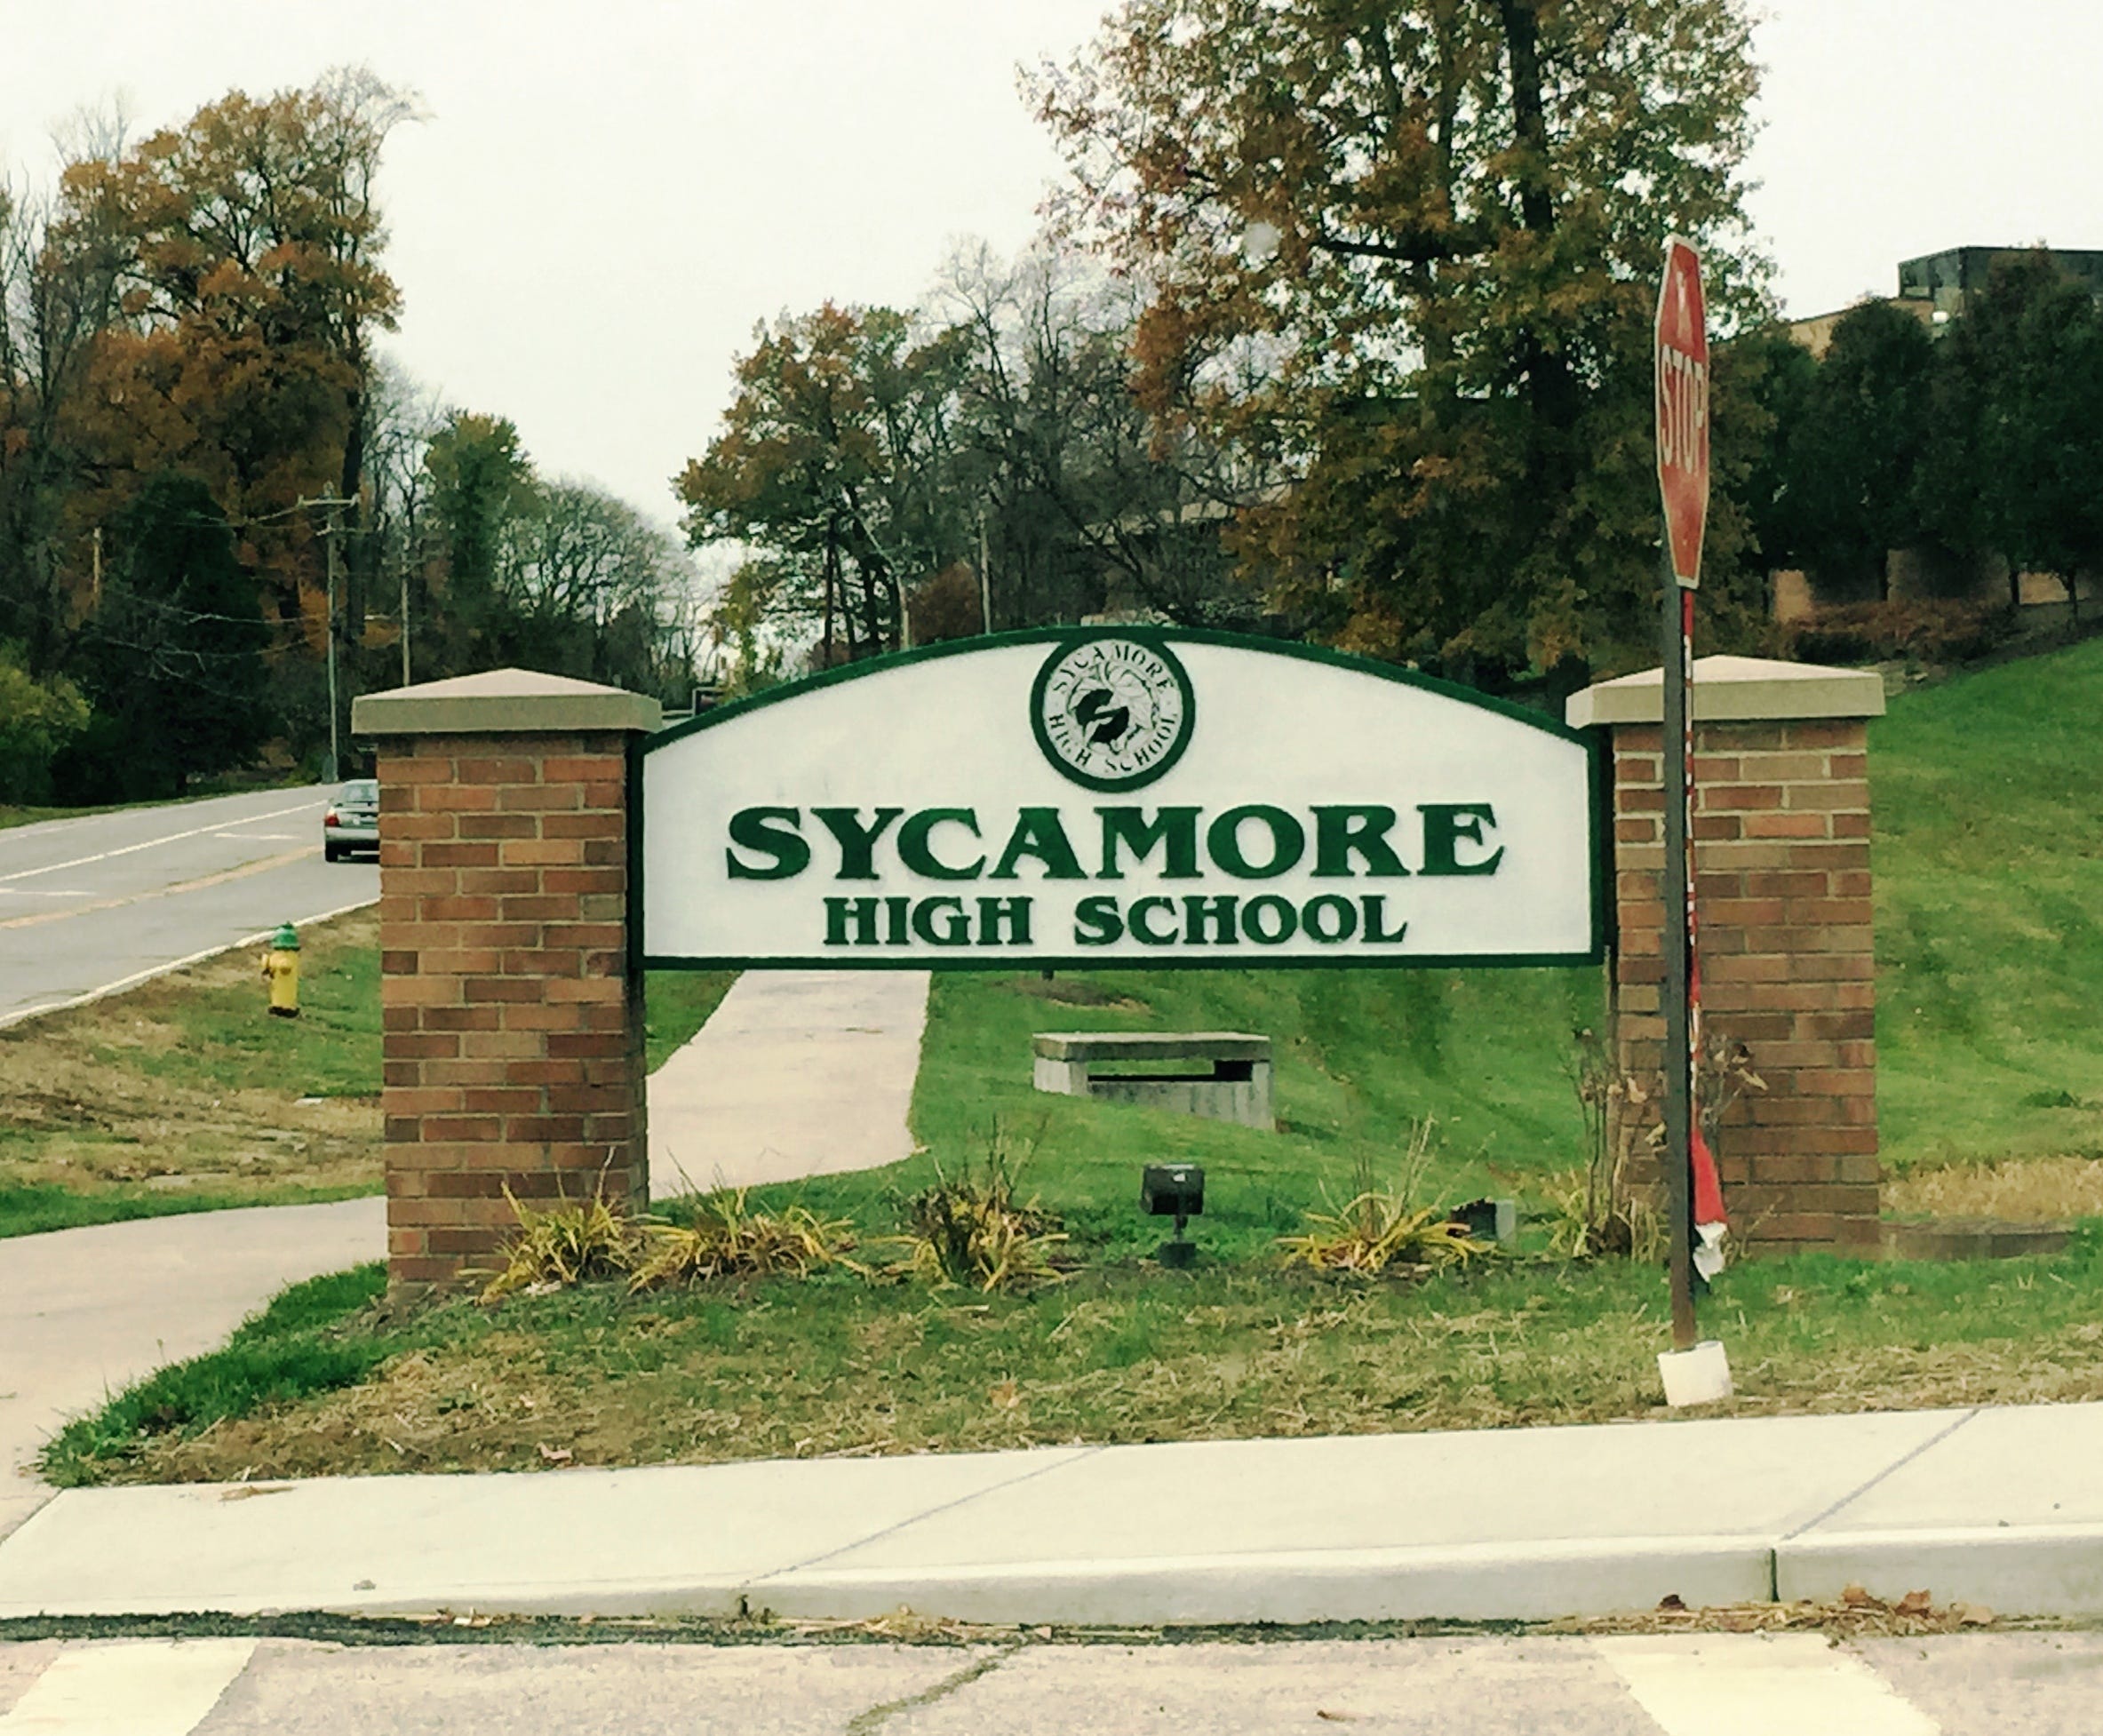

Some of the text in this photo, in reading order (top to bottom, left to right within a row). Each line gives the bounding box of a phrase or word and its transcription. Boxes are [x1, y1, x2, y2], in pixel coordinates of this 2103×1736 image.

[1661, 343, 1707, 477] STOP
[1053, 644, 1175, 693] SYCAMORE
[725, 803, 1505, 881] SYCAMORE
[823, 894, 1408, 946] HIGH SCHOOL
